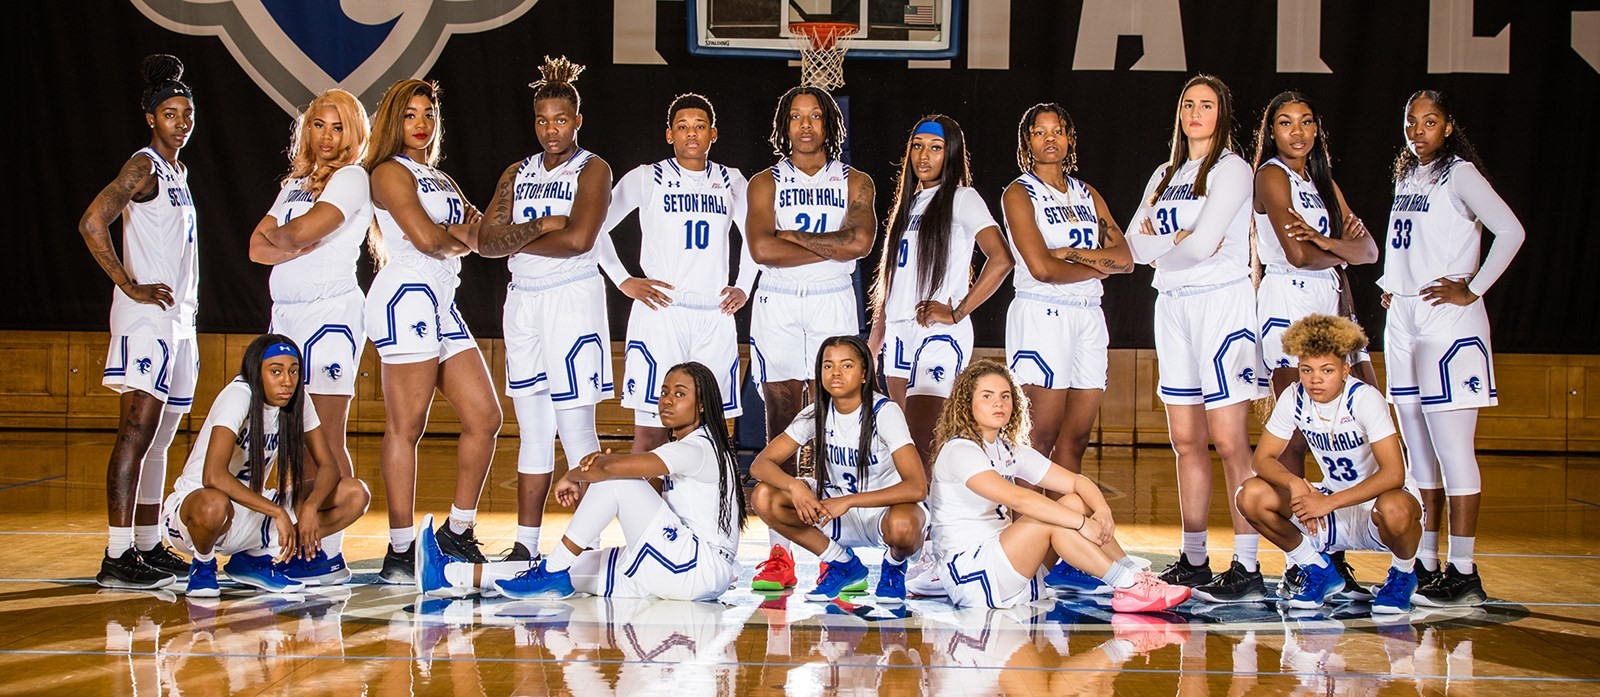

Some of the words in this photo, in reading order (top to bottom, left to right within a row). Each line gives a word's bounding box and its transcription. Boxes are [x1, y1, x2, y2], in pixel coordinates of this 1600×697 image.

[543, 181, 572, 200] HALL
[779, 188, 814, 208] SETON
[816, 188, 844, 208] HALL
[664, 193, 699, 213] SETON
[701, 193, 727, 215] HALL
[795, 212, 827, 233] 24
[1157, 207, 1179, 235] 31
[684, 220, 710, 249] 10
[1069, 227, 1094, 249] 25
[1392, 218, 1413, 249] 33
[1332, 431, 1365, 451] HALL
[1322, 456, 1358, 481] 23
